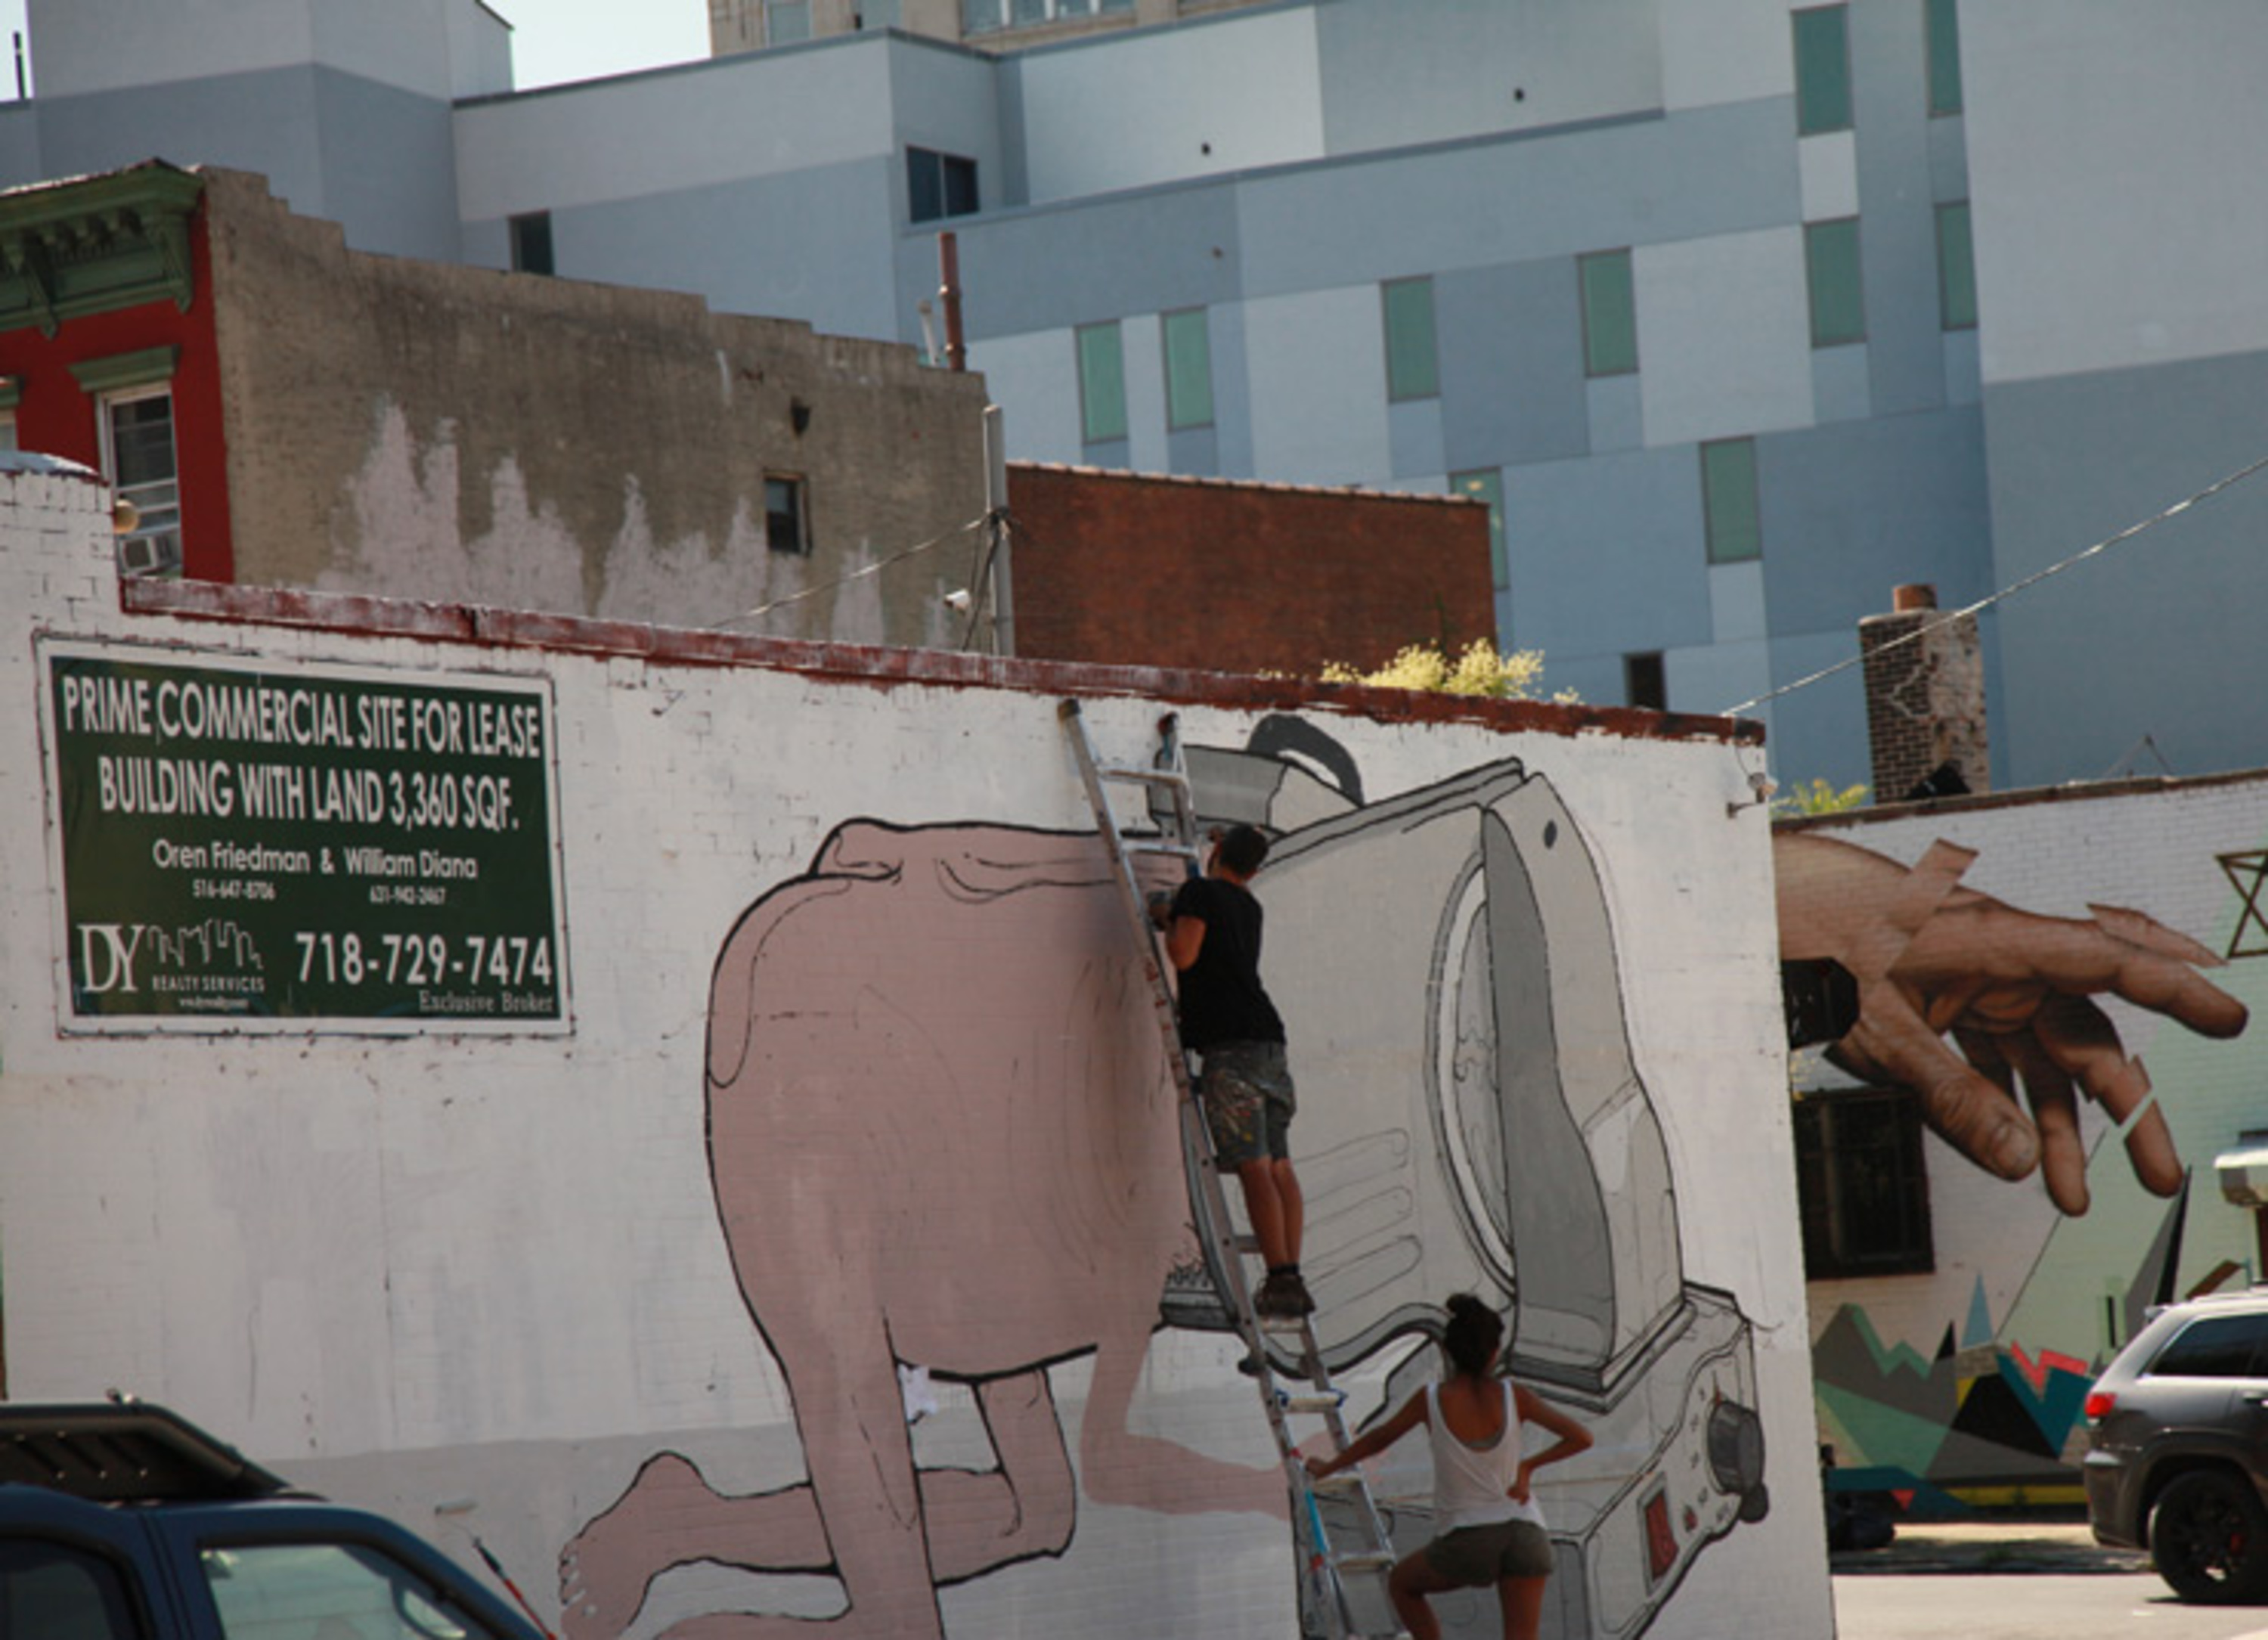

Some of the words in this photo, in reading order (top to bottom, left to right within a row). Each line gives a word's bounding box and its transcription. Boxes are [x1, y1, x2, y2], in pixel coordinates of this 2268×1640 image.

[64, 676, 151, 735] PRIME
[157, 680, 353, 747] COMMERCIAL
[358, 694, 407, 749] SITE
[411, 699, 463, 753] FOR
[469, 702, 540, 758] LEASE
[99, 756, 233, 817] BUILDING
[239, 762, 306, 820] WITH
[311, 767, 384, 823] LAND
[389, 770, 458, 832] 3,360
[463, 774, 519, 832] SQF.
[153, 839, 208, 870] Oren
[211, 841, 311, 873] Friedman
[321, 847, 335, 875] &
[344, 847, 416, 878] William
[420, 850, 479, 880] Diana
[76, 924, 147, 993] DY
[152, 975, 200, 991] REALTY
[202, 975, 265, 993] SERVICES
[295, 932, 552, 985] 718-729-7474
[419, 991, 495, 1013] Exclusive
[501, 992, 554, 1014] Broker
